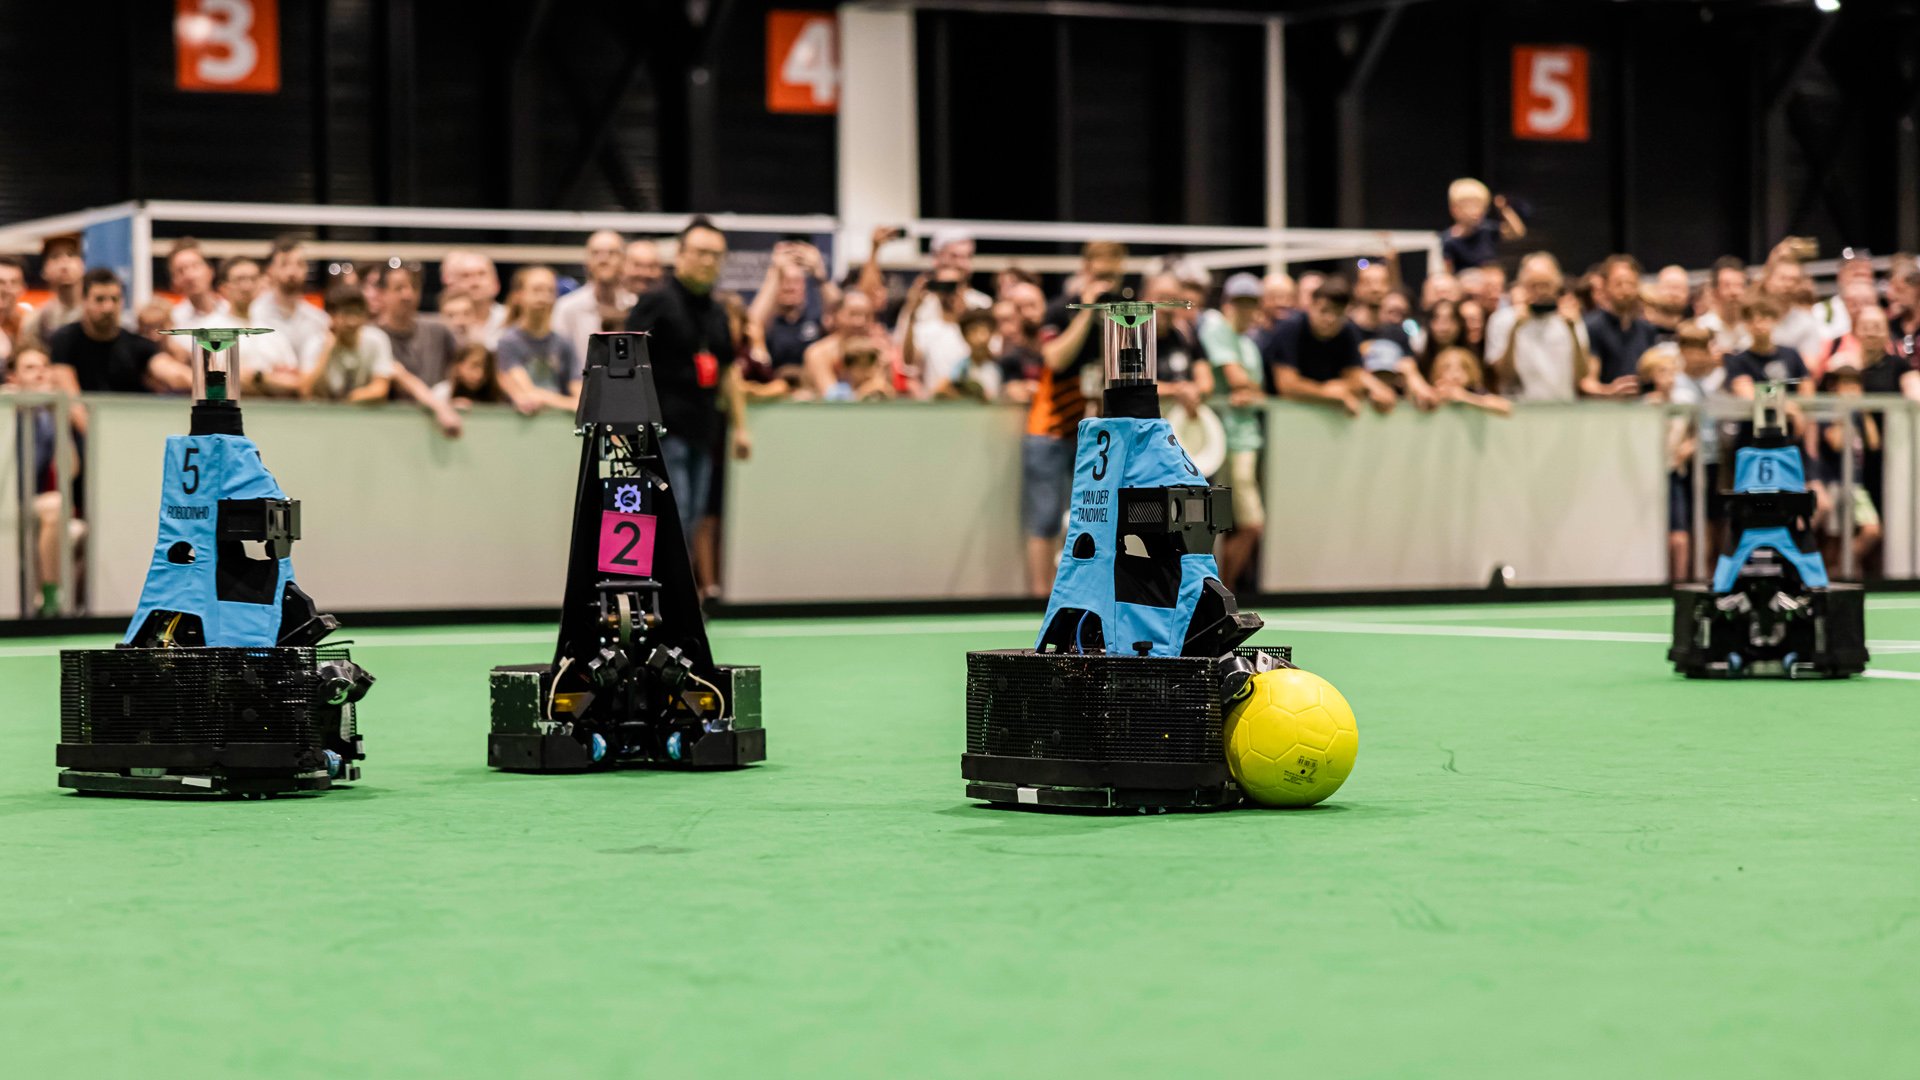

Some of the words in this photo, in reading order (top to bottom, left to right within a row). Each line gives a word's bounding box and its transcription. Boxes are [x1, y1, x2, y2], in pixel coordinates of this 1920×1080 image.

[197, 0, 258, 83] 3
[782, 20, 840, 105] 4
[1528, 53, 1573, 133] 5
[182, 447, 200, 495] 5
[1092, 429, 1111, 481] 3
[1167, 434, 1199, 477] 3
[1759, 456, 1773, 484] 6
[166, 505, 210, 520] ROBODINHO
[1077, 507, 1109, 523] TANDWIEL
[1082, 490, 1096, 505] VAN
[1095, 489, 1110, 505] DER
[609, 520, 641, 567] 2
